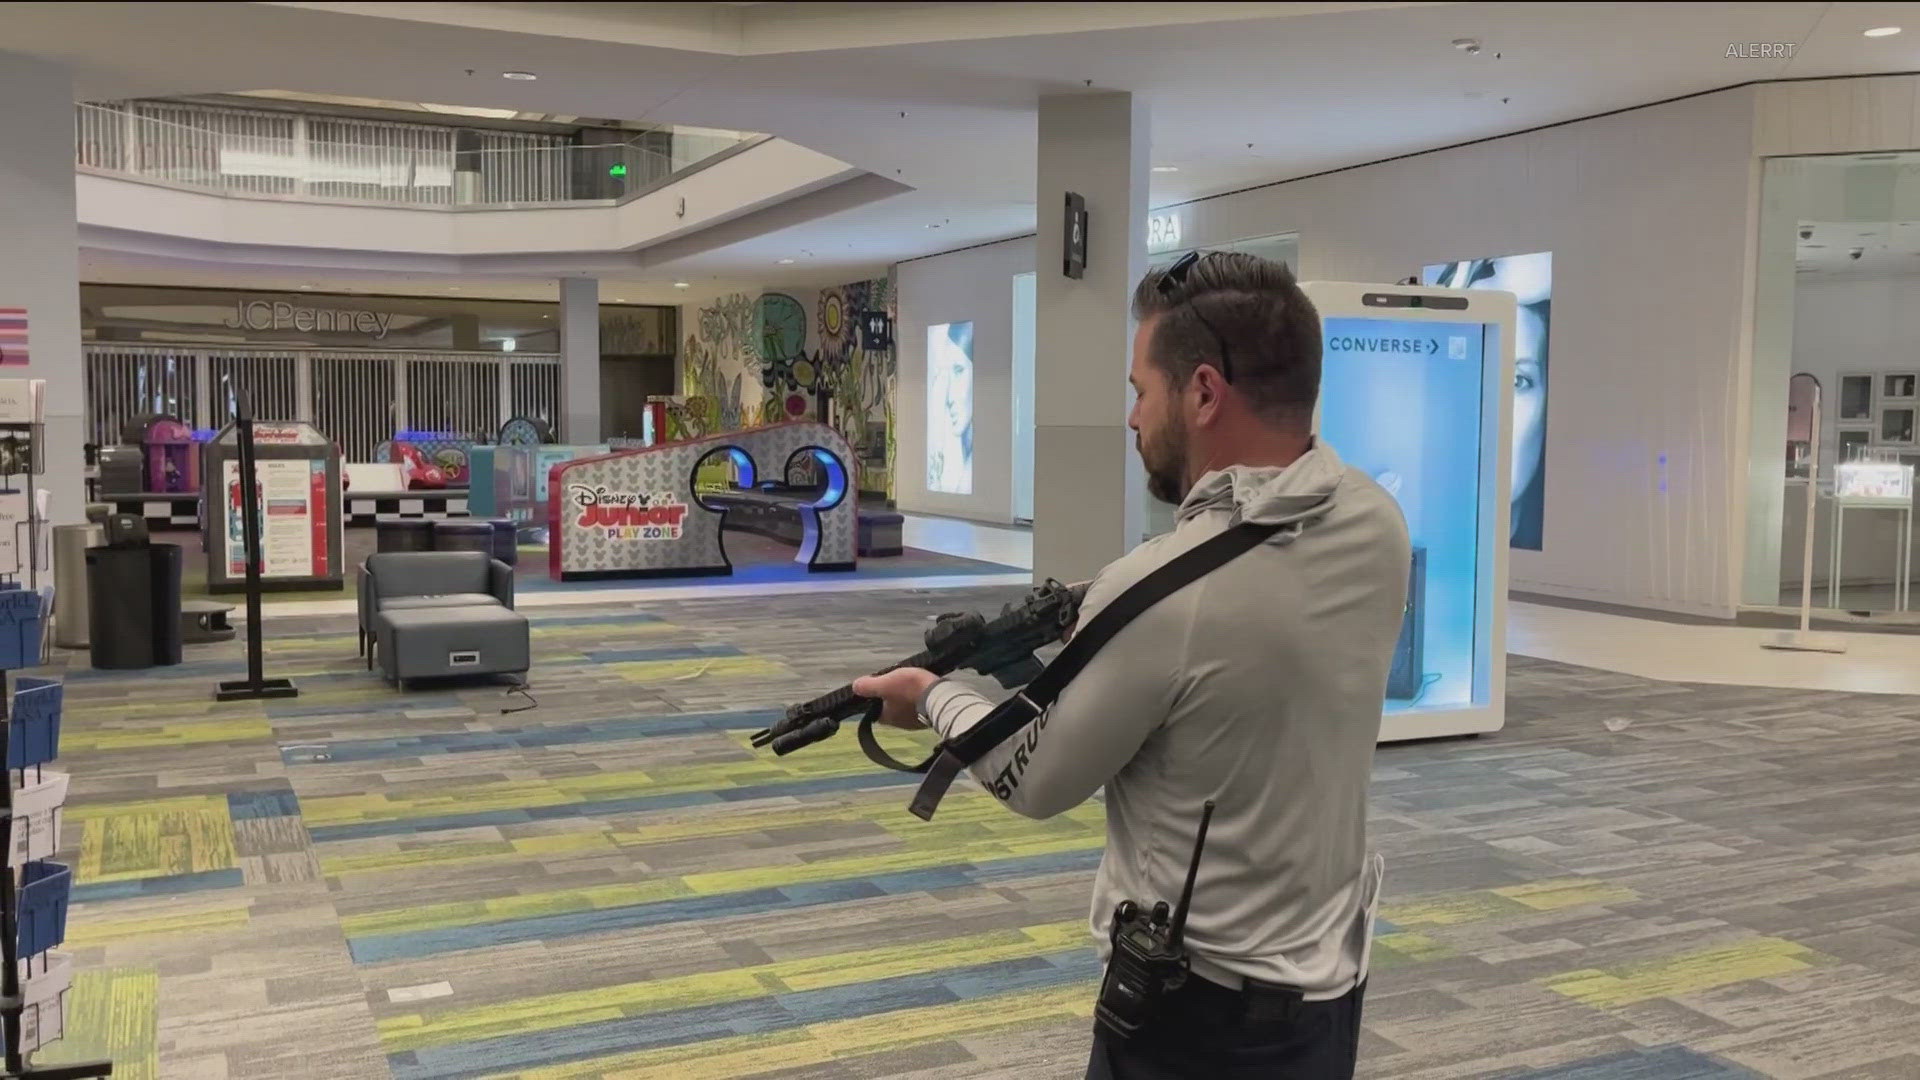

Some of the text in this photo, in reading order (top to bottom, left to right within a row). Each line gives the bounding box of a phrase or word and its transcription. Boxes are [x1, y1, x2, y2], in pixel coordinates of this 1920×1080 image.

[1148, 216, 1179, 242] RA
[223, 300, 394, 340] JCPenney
[1329, 337, 1422, 353] CONVERSE
[608, 527, 678, 539] PLAY ZONE
